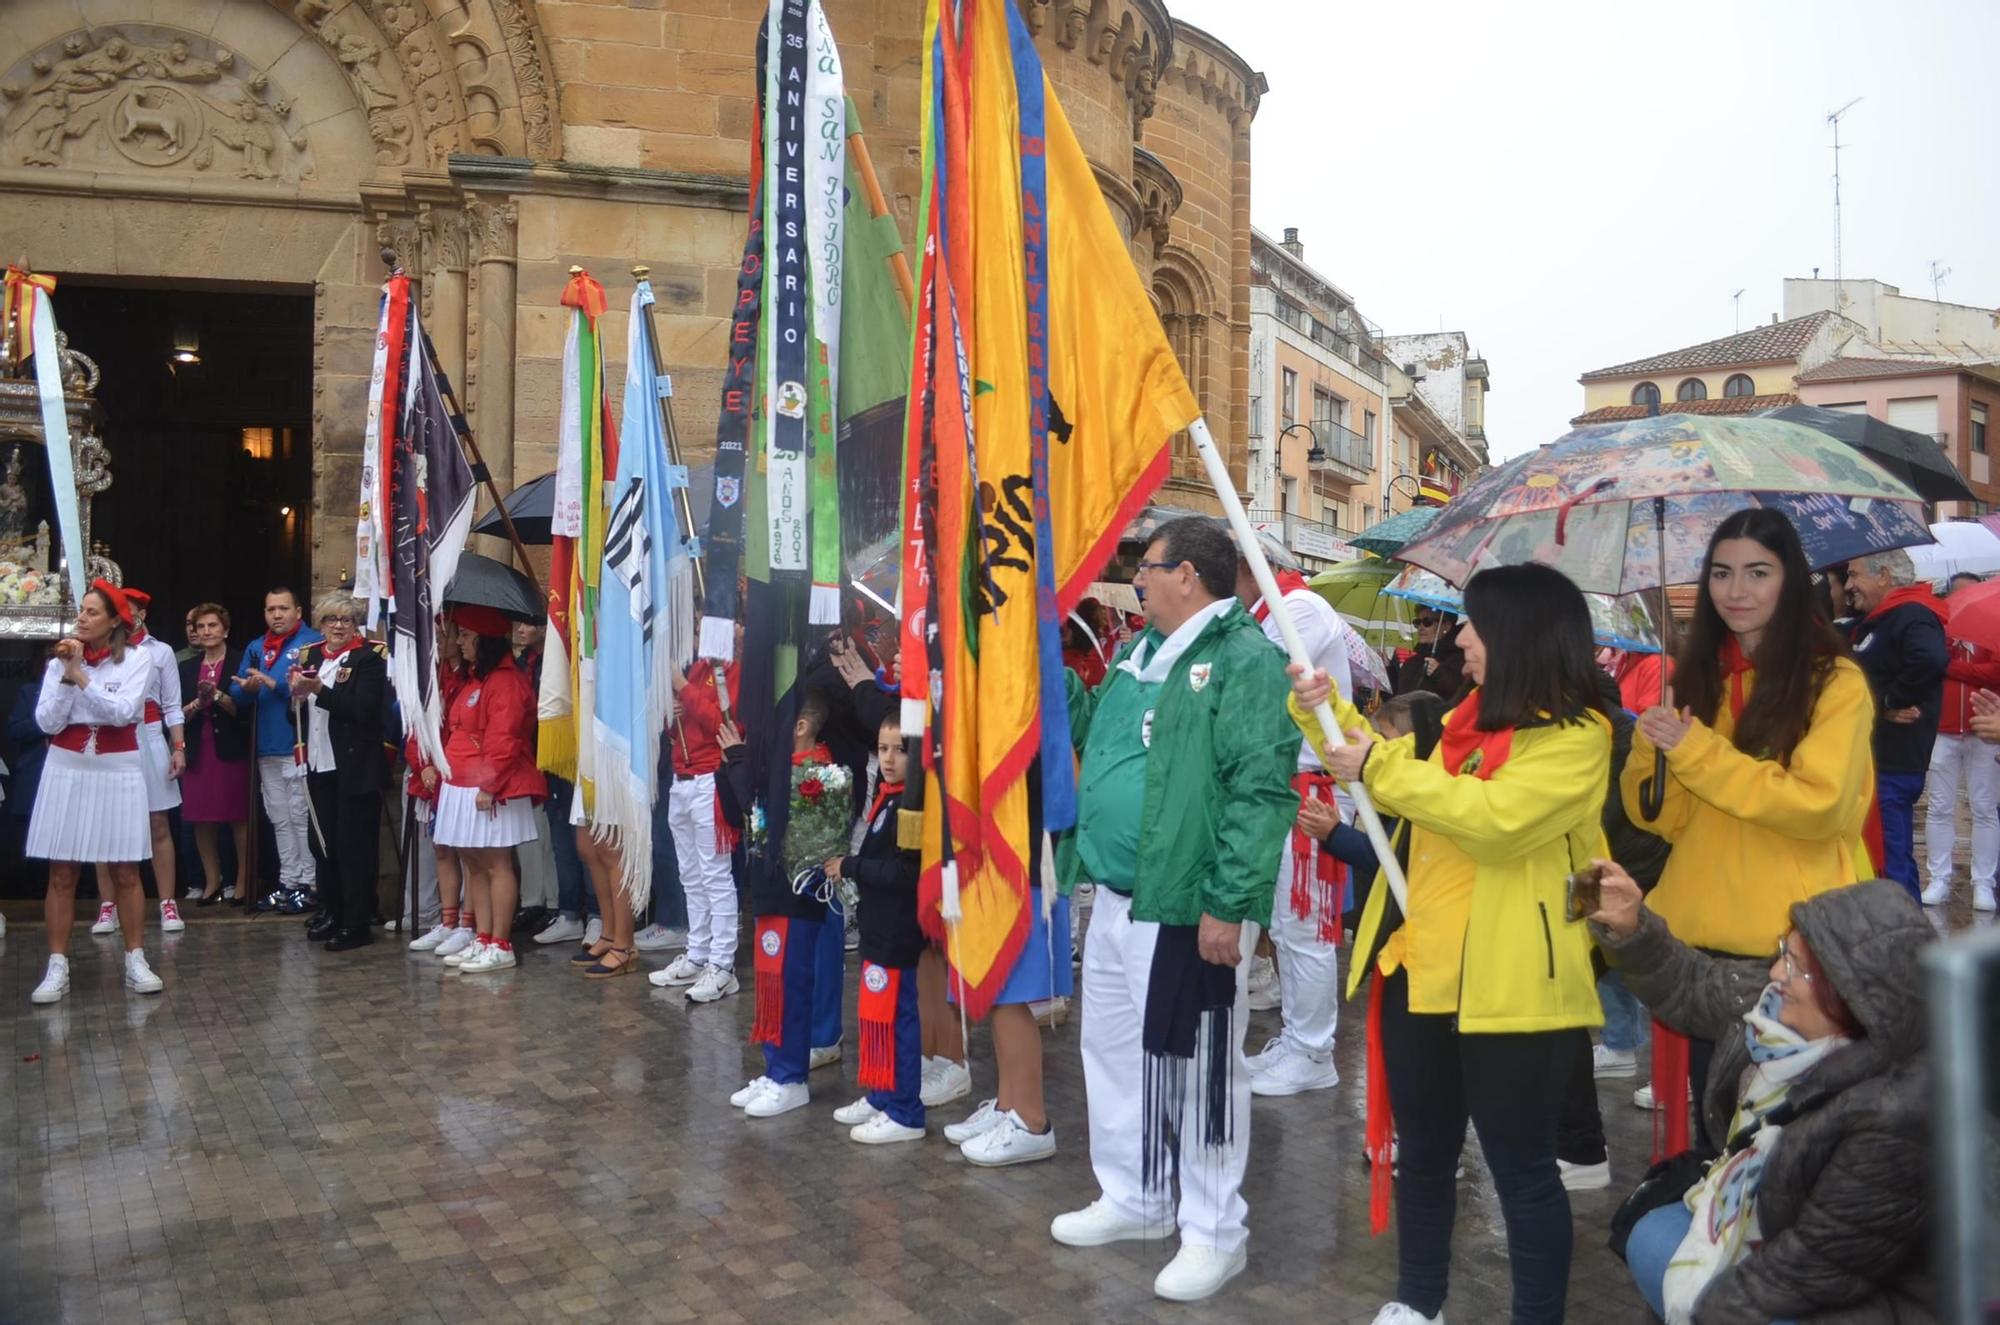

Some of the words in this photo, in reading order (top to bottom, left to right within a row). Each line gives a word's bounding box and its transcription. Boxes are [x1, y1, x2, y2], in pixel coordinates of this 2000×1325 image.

[786, 33, 803, 49] 35
[785, 66, 800, 343] ANIVERSARIO
[824, 177, 840, 306] ISIDRO
[727, 219, 761, 412] POPEYE
[1022, 190, 1048, 521] ANIVERSARIO
[720, 441, 743, 451] 2021
[792, 518, 802, 564] 2001
